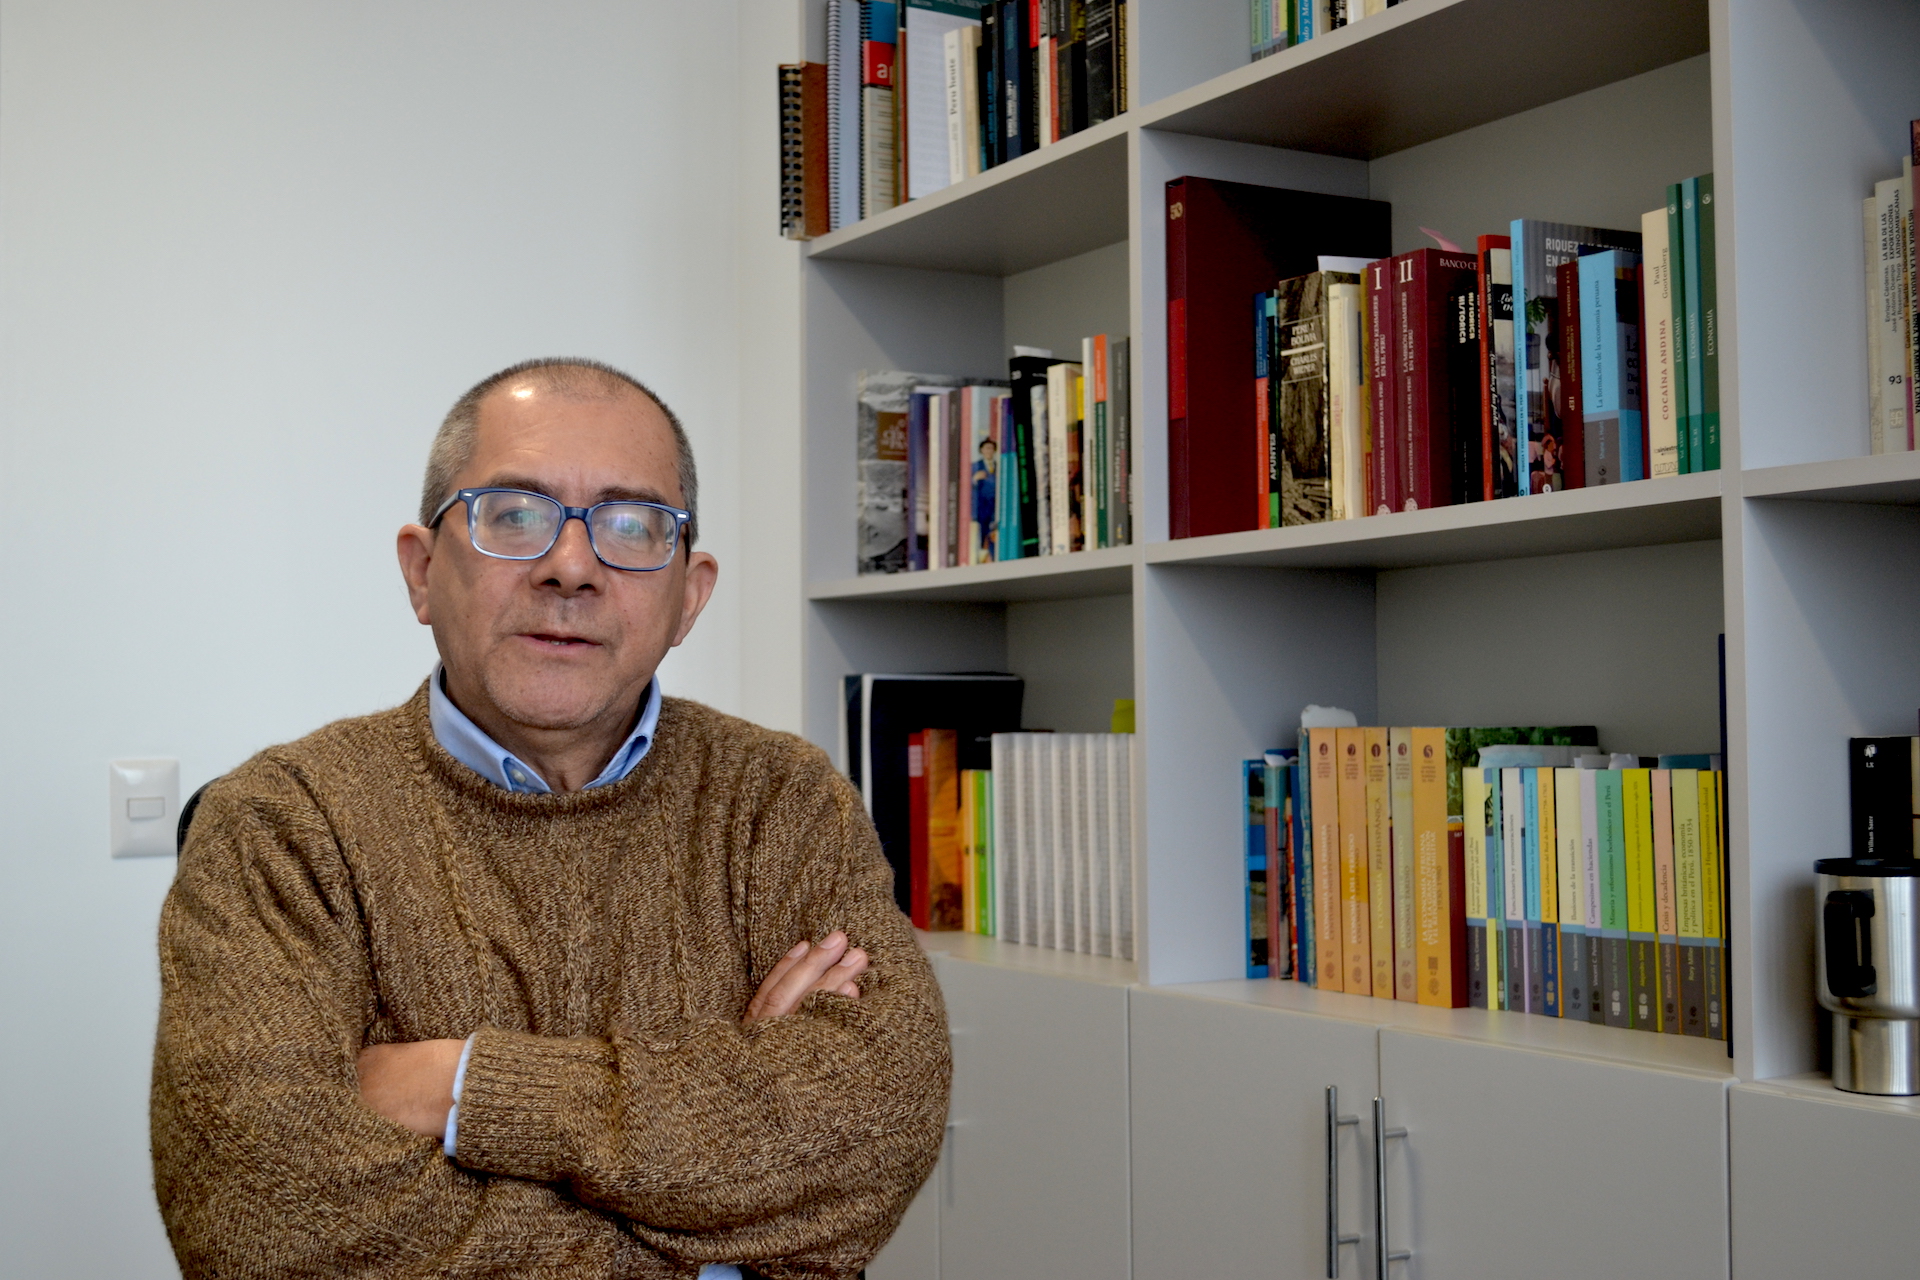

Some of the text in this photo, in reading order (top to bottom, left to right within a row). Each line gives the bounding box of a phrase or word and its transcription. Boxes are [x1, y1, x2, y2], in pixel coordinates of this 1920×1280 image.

[1882, 227, 1887, 236] DE
[1546, 238, 1583, 253] RIQUEZ
[1546, 255, 1558, 266] EN
[1883, 252, 1888, 261] LA
[1440, 258, 1467, 269] BANCO
[1399, 259, 1413, 283] II
[1660, 247, 1669, 299] Gootenberg
[1594, 281, 1602, 308] peruana
[1706, 309, 1714, 356] ECONOMÍA
[1674, 317, 1682, 362] ECONOMÍA
[1290, 353, 1317, 366] CHARLES
[1380, 355, 1386, 364] EL
[1408, 349, 1414, 359] EL
[1381, 365, 1386, 377] EN
[1403, 362, 1408, 372] LA
[1409, 360, 1414, 371] EN
[1659, 319, 1669, 420] COCAÍNA ANDINA
[1375, 367, 1380, 378] LA
[1595, 362, 1603, 398] formación
[1888, 375, 1902, 385] 93
[1596, 400, 1603, 408] La
[1607, 810, 1612, 818] en
[1686, 818, 1694, 857] 1850-1934
[1704, 814, 1712, 866] Hispanoamérica
[1322, 865, 1328, 875] LA
[1706, 867, 1712, 875] en
[1588, 873, 1593, 881] en
[1680, 860, 1688, 897] británicas,
[1323, 879, 1328, 889] DE
[1570, 881, 1576, 889] de
[1690, 889, 1695, 898] en
[1608, 899, 1616, 925] Minería
[1682, 899, 1690, 932] Empresas
[1689, 899, 1697, 927] política
[1349, 894, 1357, 944] ECONOMÍA
